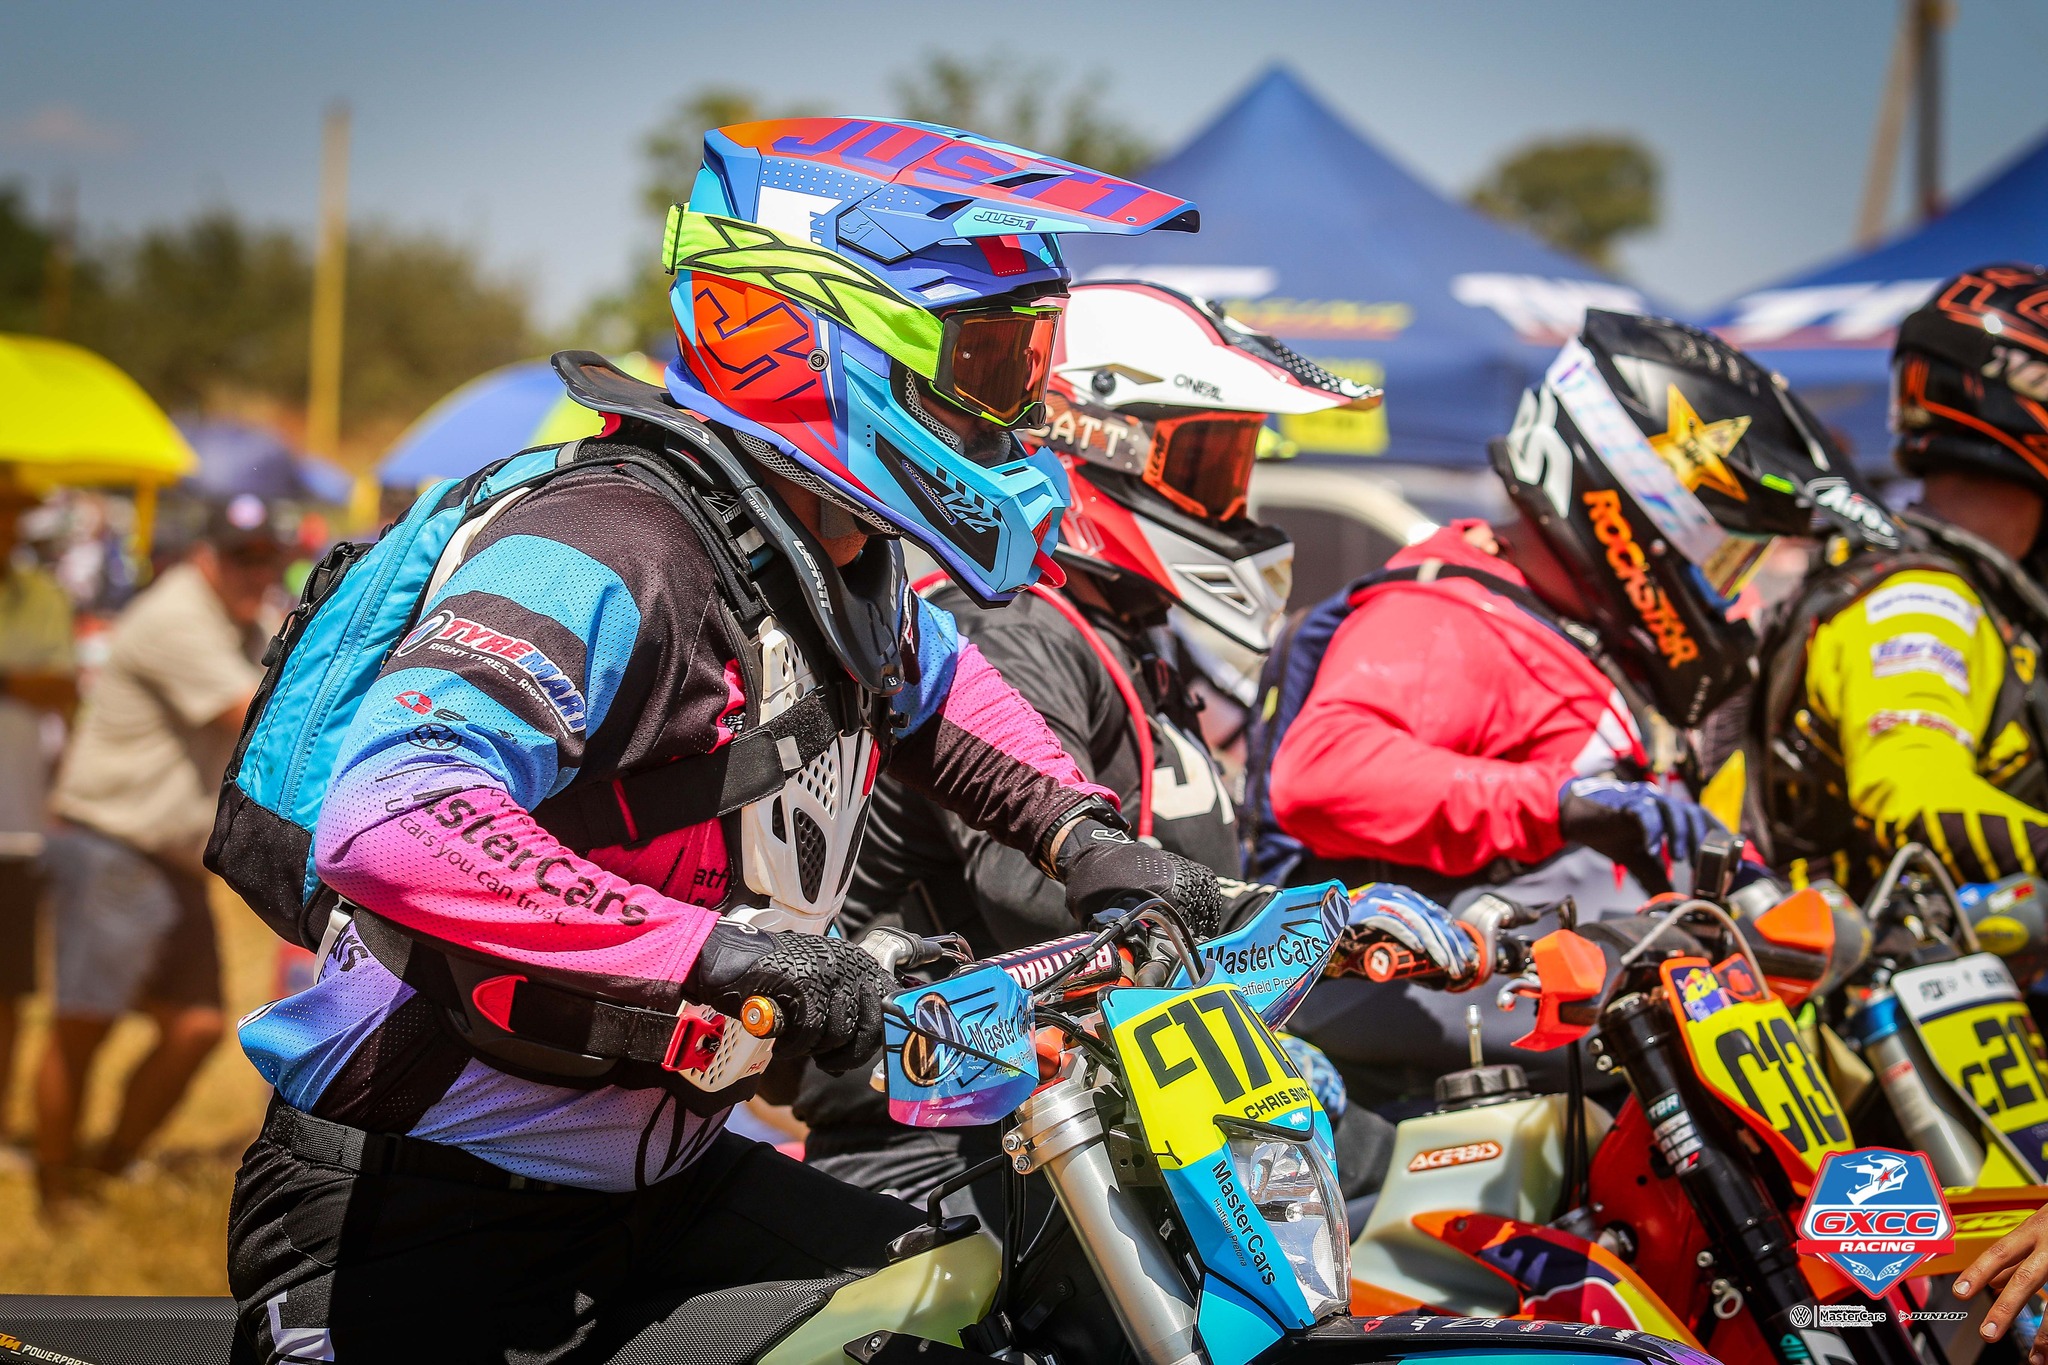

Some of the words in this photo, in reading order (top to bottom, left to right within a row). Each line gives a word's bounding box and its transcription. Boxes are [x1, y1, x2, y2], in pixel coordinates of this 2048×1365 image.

[973, 210, 1038, 231] JUST1
[792, 539, 834, 615] LEATT
[429, 642, 469, 658] RIGHT
[399, 816, 439, 848] cars
[430, 842, 476, 876] you
[476, 870, 514, 901] can
[1240, 978, 1273, 997] atfield
[1243, 1089, 1293, 1121] CHRIS
[1715, 1017, 1848, 1153] C13
[1410, 1140, 1499, 1172] ACERBIS
[1211, 1159, 1276, 1286] MasterCars
[1213, 1197, 1234, 1235] Hatfield
[1231, 1233, 1248, 1268] Pretoria
